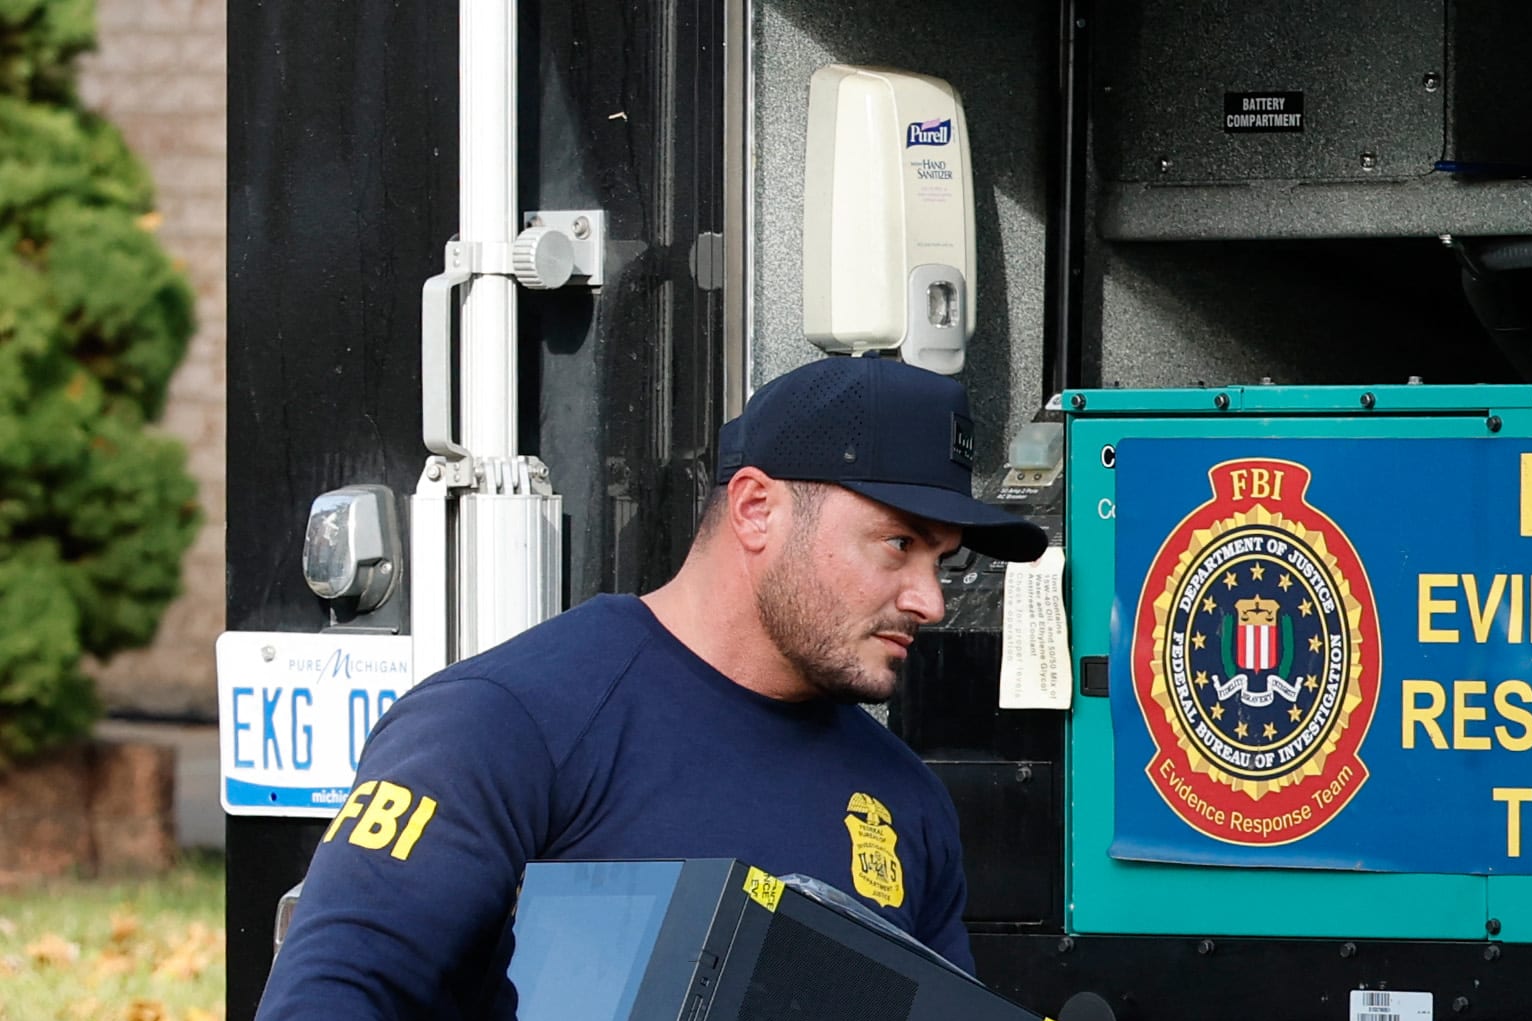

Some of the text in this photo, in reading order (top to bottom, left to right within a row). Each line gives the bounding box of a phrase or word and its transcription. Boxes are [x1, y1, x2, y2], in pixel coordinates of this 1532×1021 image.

[1226, 113, 1302, 128] COMPARTMENT
[1242, 97, 1285, 111] BATTERY
[909, 124, 948, 144] Purell
[1230, 467, 1285, 501] FBI
[1035, 573, 1043, 599] Water
[1178, 536, 1335, 614] DEPARTMENT OF JUSTICE
[1027, 573, 1038, 657] Antifreeze Coolant
[1037, 621, 1047, 660] Ethylene
[288, 648, 408, 685] PURE MICHIGAN
[1039, 663, 1048, 692] Glycol
[1171, 631, 1342, 769] FEDERAL BUREAU OF INVESTIGATION
[232, 686, 314, 771] EKG
[1159, 757, 1354, 838] Evidence Response Team
[322, 779, 438, 861] FBI
